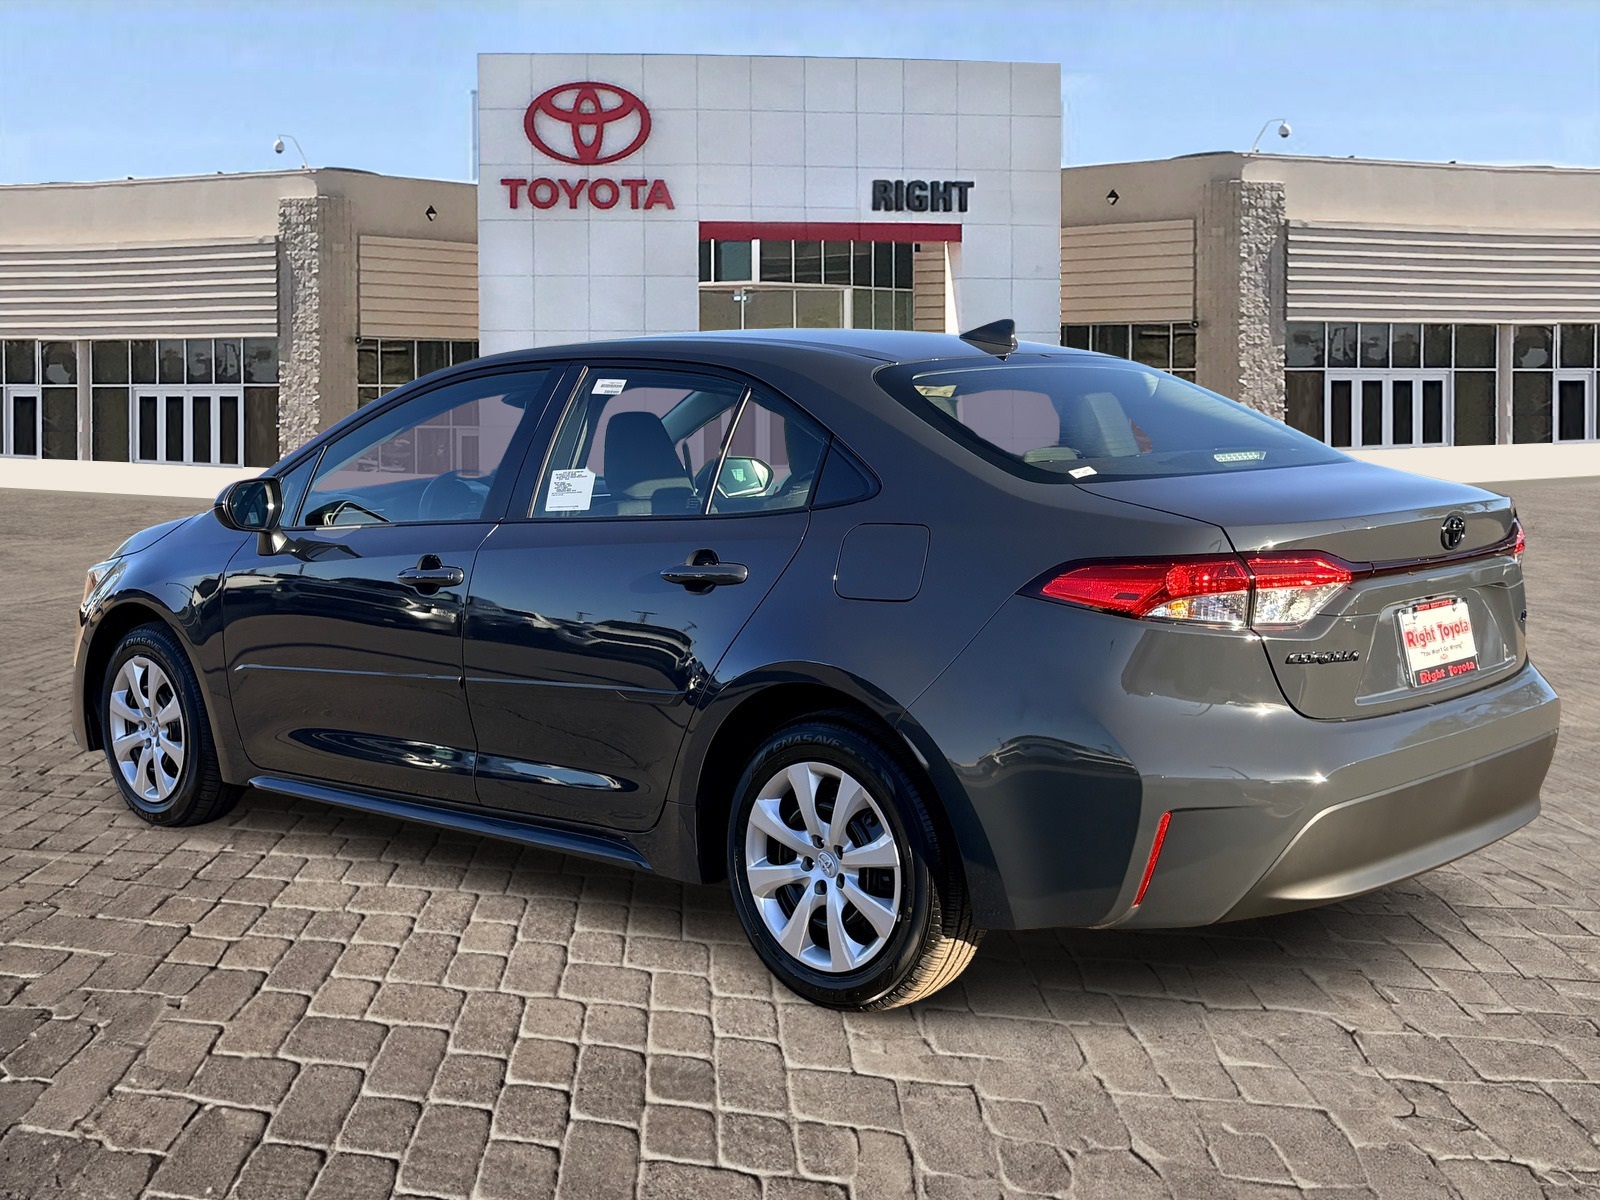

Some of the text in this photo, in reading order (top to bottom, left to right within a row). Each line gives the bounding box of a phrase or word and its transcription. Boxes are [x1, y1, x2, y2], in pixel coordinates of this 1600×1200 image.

[500, 178, 675, 210] TOYOTA
[871, 179, 975, 213] RIGHT
[1405, 618, 1470, 648] Right Toyota
[1285, 650, 1360, 664] COROLLA
[1420, 661, 1475, 684] Right Toyota
[772, 733, 841, 753] ENASAVE
